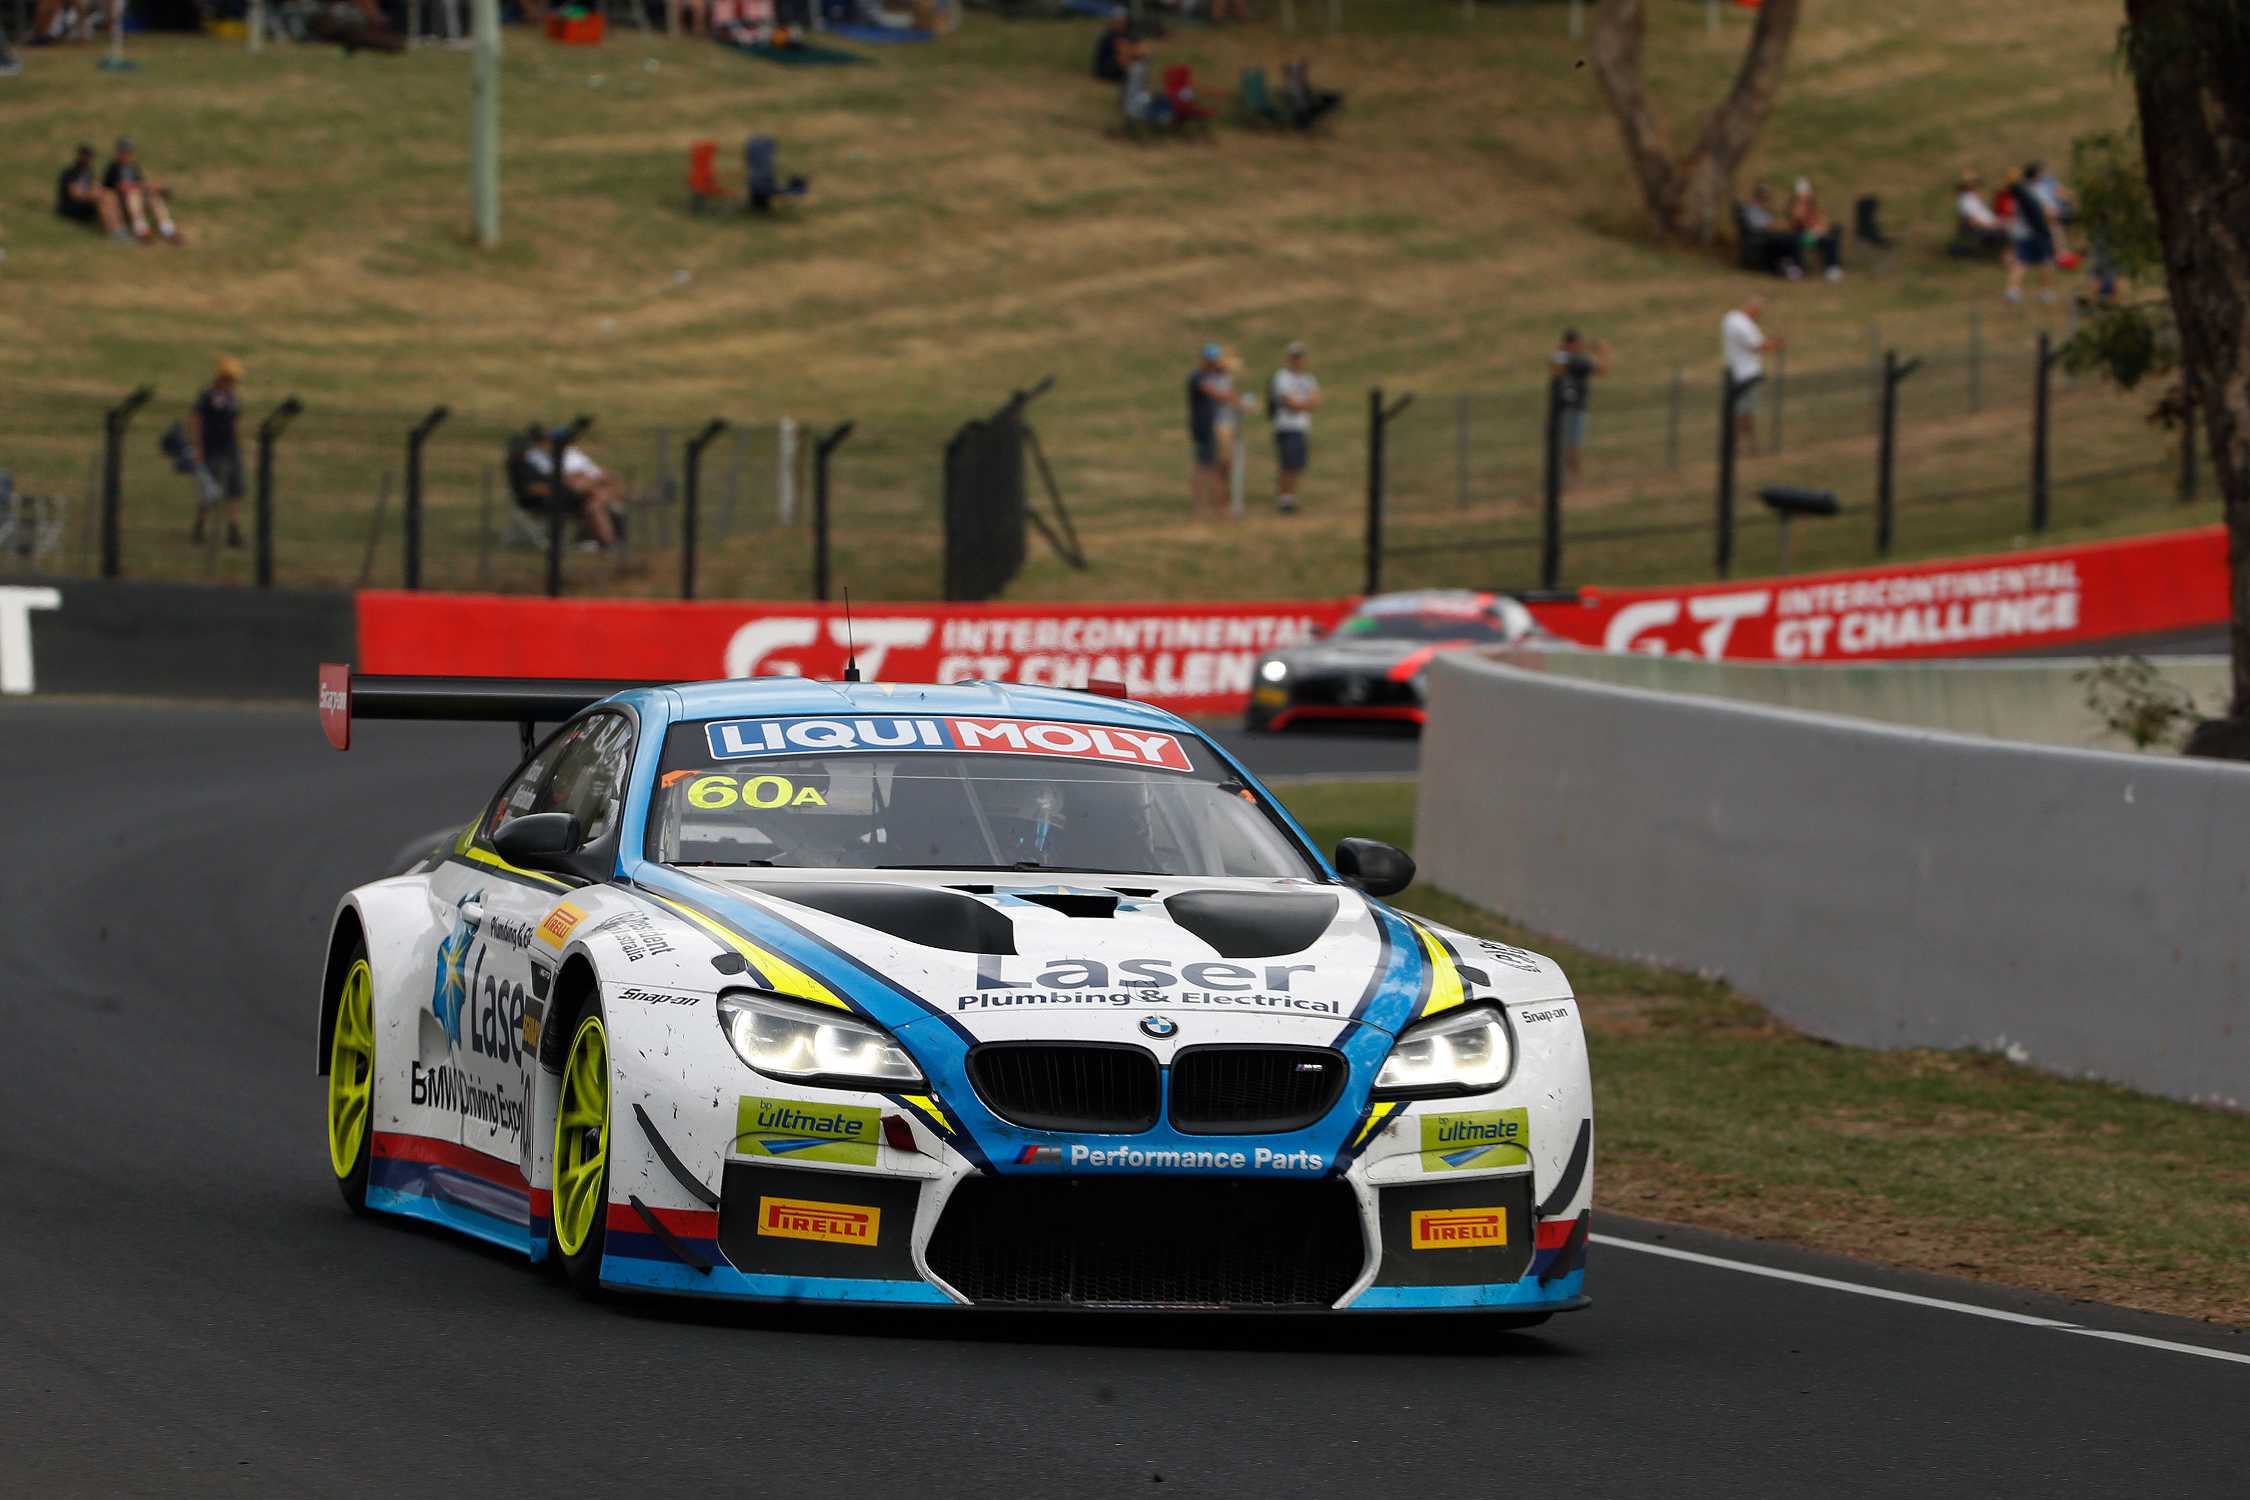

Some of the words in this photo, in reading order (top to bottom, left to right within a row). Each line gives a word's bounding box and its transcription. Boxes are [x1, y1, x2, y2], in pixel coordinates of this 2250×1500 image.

[1776, 561, 2080, 614] INTERCONTINENTAL
[942, 617, 1313, 651] INTERCONTINENTAL
[1774, 617, 1832, 657] GT
[1838, 592, 2078, 652] CHALLENGE
[937, 655, 1011, 684] GT
[1018, 652, 1255, 695] CHALLEN
[721, 719, 943, 754] LIQUI
[958, 723, 1169, 762] MOLY
[976, 954, 1316, 991] Laser
[957, 991, 1130, 1010] Plumbing
[1139, 989, 1169, 1003] &
[1182, 991, 1340, 1014] Electrical
[410, 1060, 458, 1112] BMW
[757, 1108, 864, 1135] ultimate
[1438, 1119, 1518, 1142] ultimate
[1070, 1144, 1246, 1169] Performance
[1253, 1147, 1324, 1171] Parts
[767, 1204, 869, 1237] PIRELLI
[1420, 1215, 1498, 1241] PIRELLI
